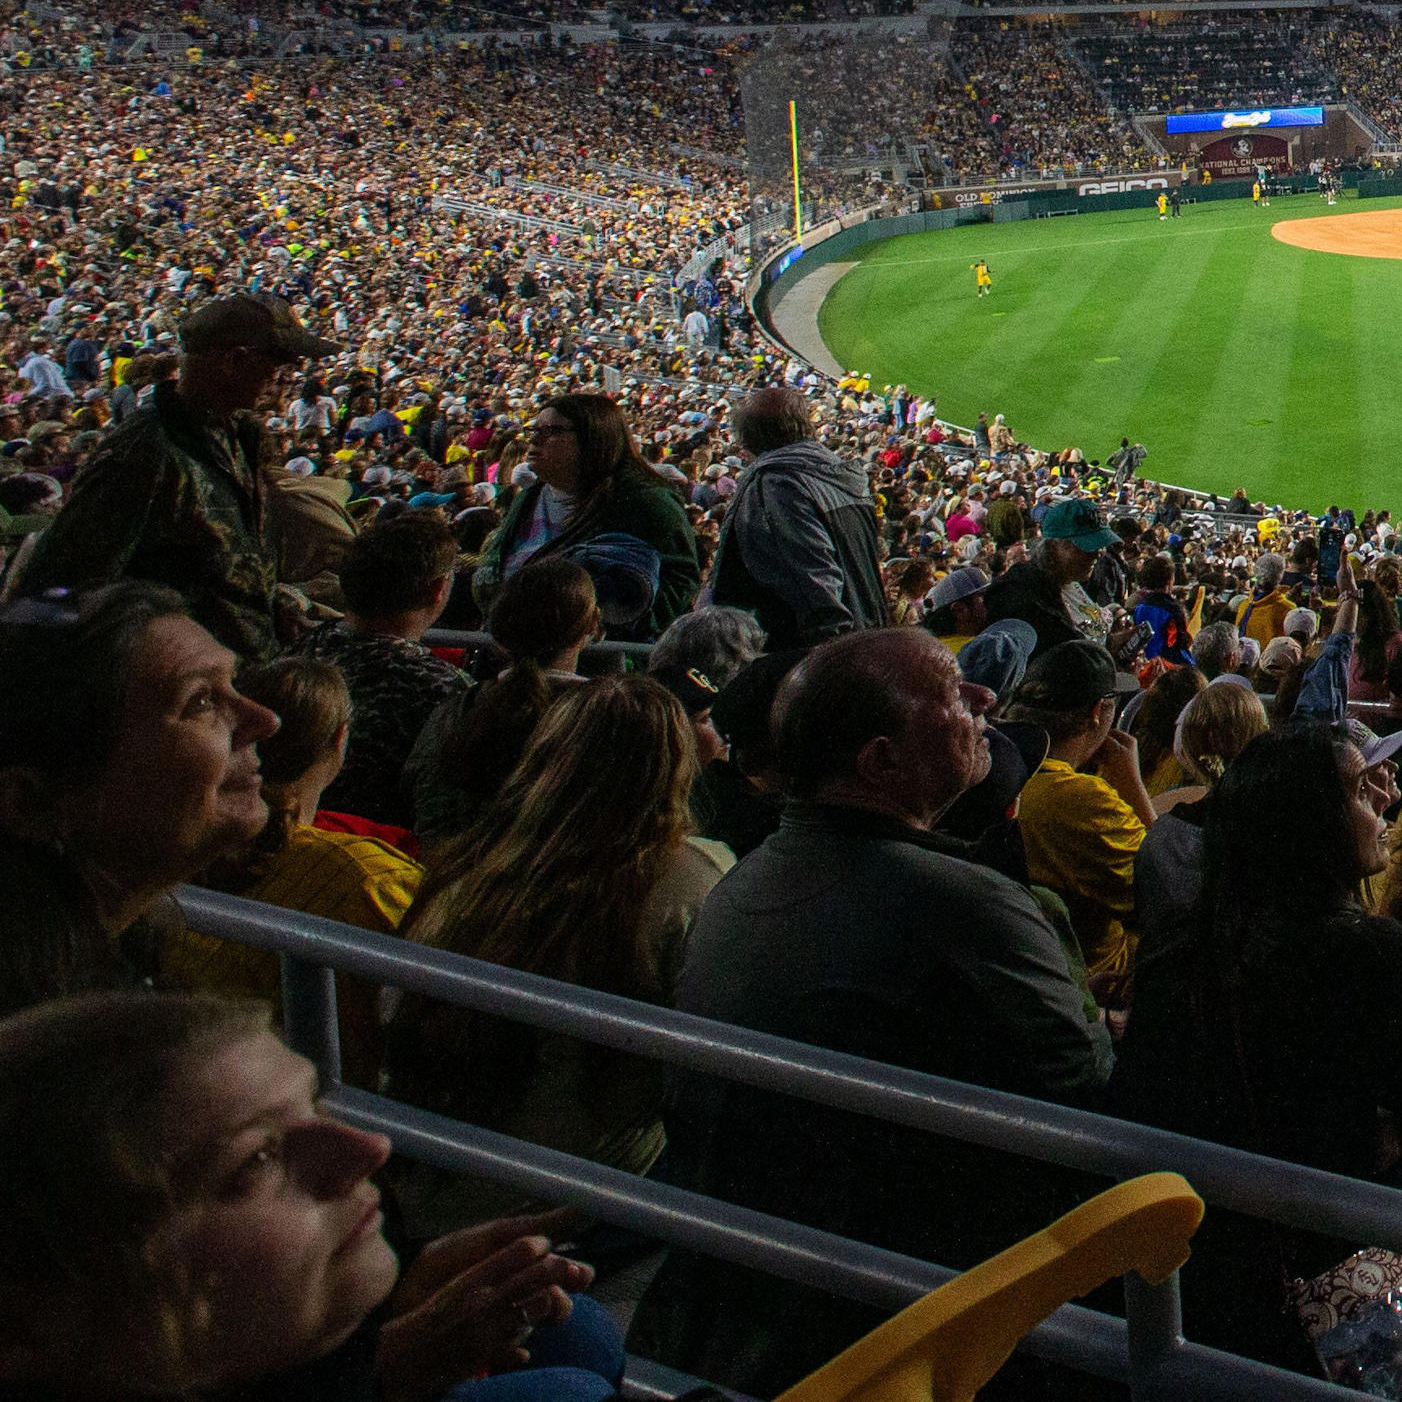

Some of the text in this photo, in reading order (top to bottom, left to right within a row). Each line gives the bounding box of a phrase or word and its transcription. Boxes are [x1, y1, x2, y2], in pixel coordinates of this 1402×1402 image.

[1079, 178, 1169, 196] GEICO
[955, 193, 978, 203] OLD
[1357, 1269, 1380, 1287] FSU
